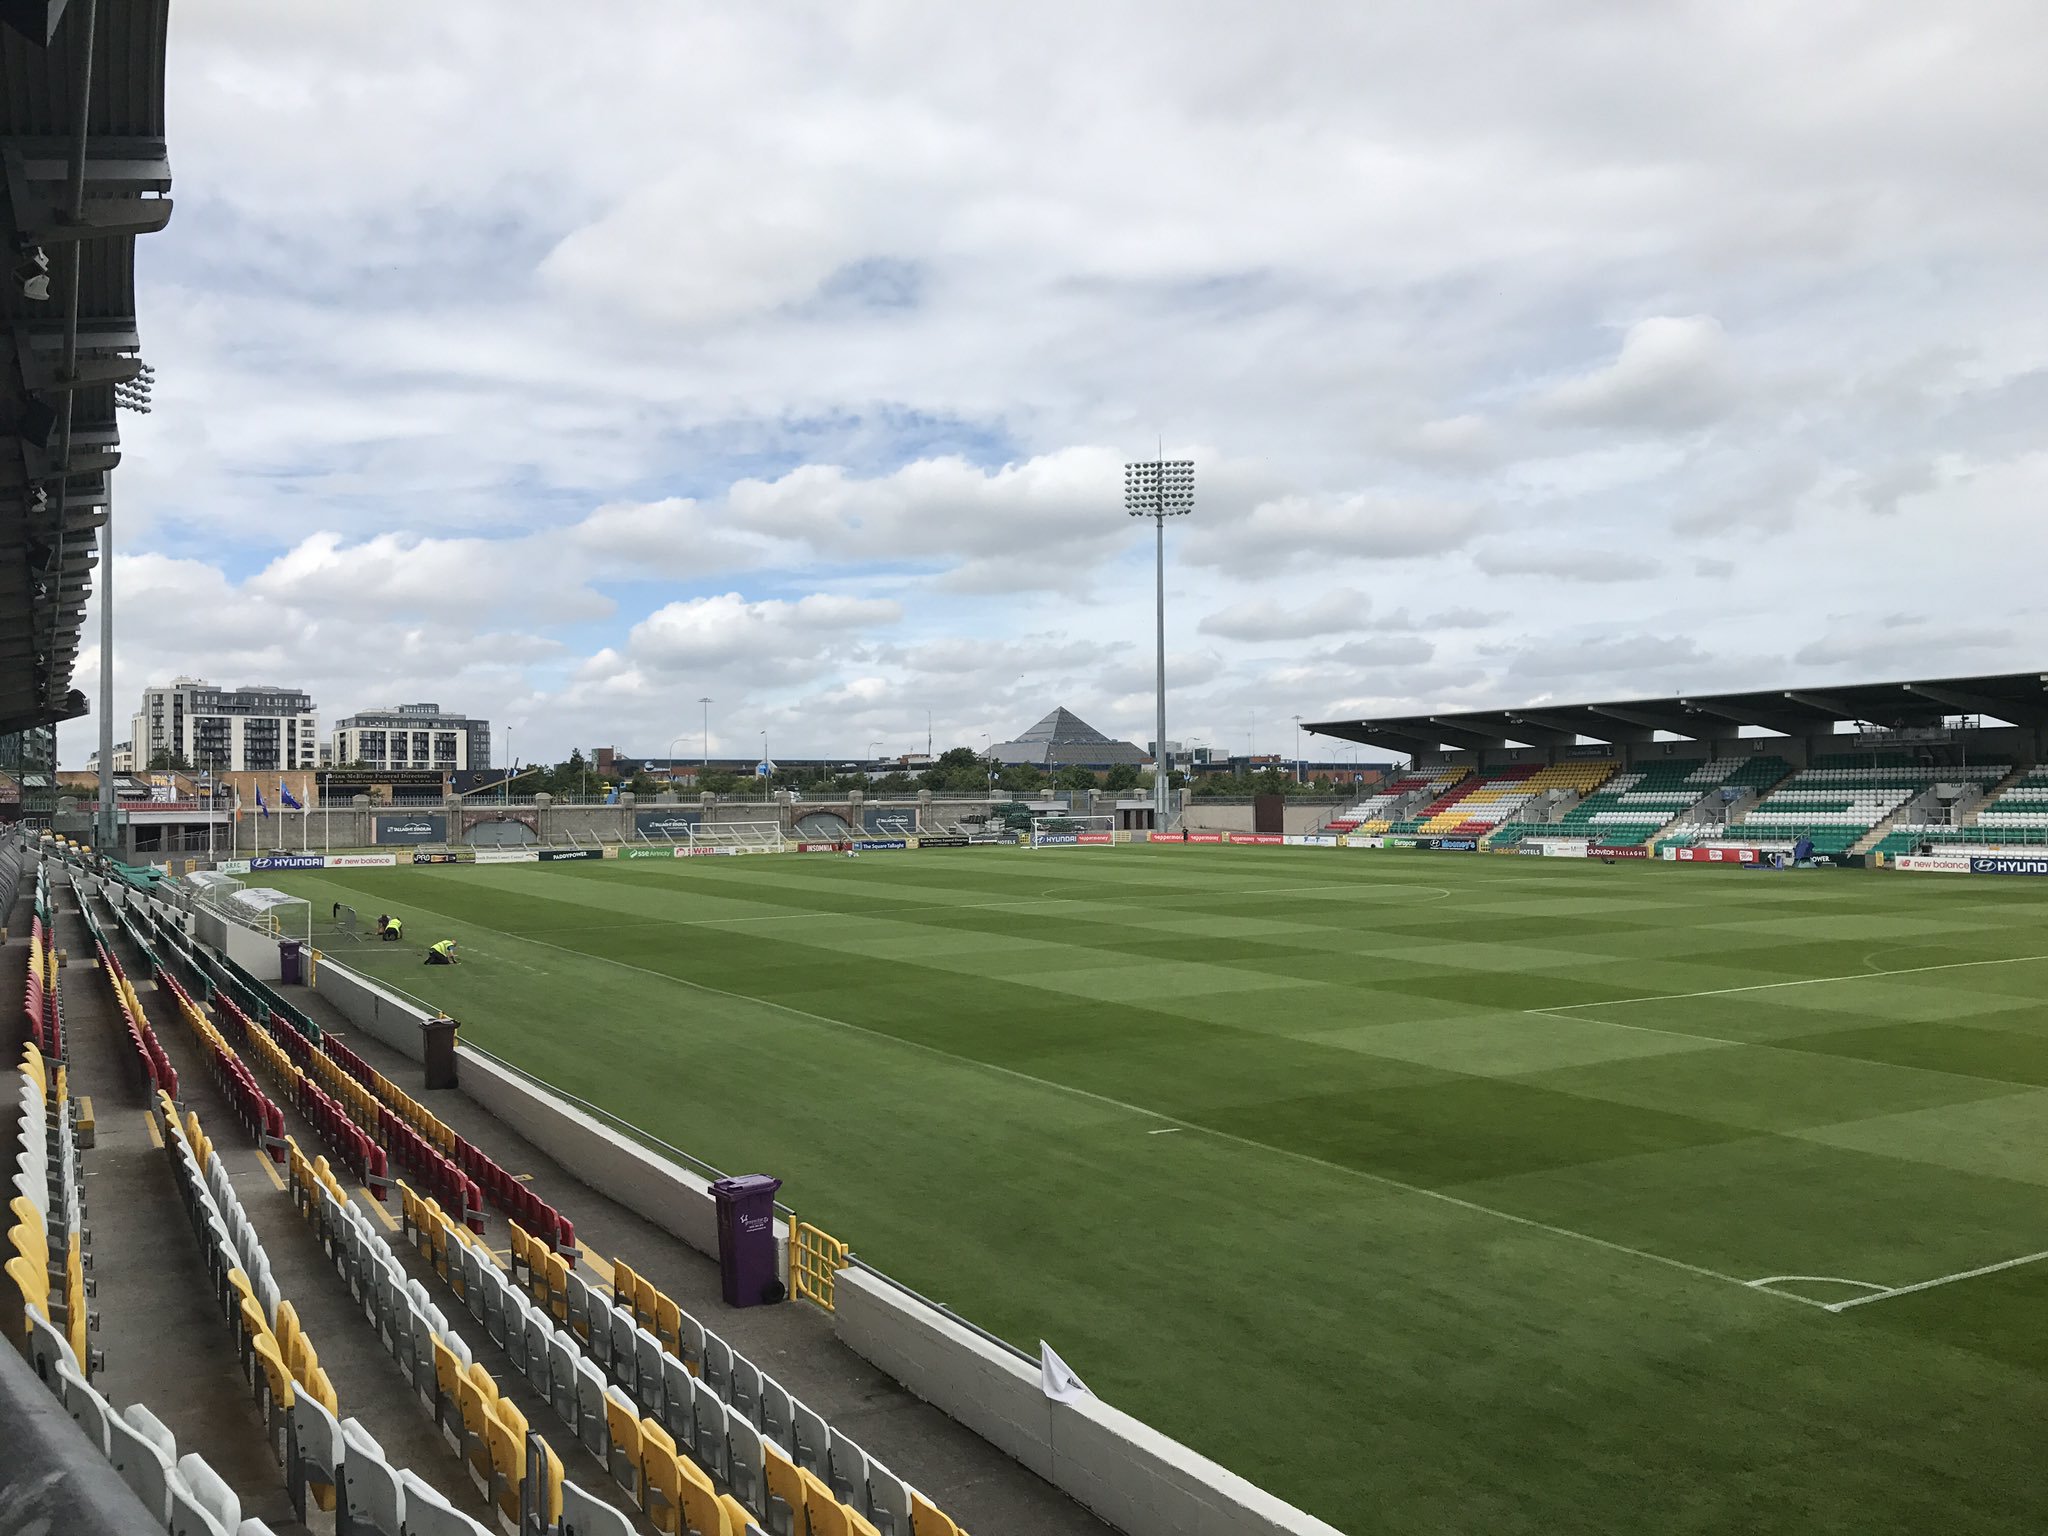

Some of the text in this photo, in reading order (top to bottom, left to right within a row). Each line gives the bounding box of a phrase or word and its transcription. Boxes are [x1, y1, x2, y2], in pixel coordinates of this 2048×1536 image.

[1046, 835, 1077, 843] HYUNDAI
[806, 844, 832, 852] INSOMNIA
[1615, 849, 1646, 857] TALLAGHT
[274, 857, 323, 867] HYUNDAI
[361, 857, 390, 865] balance
[1933, 860, 1970, 870] balance
